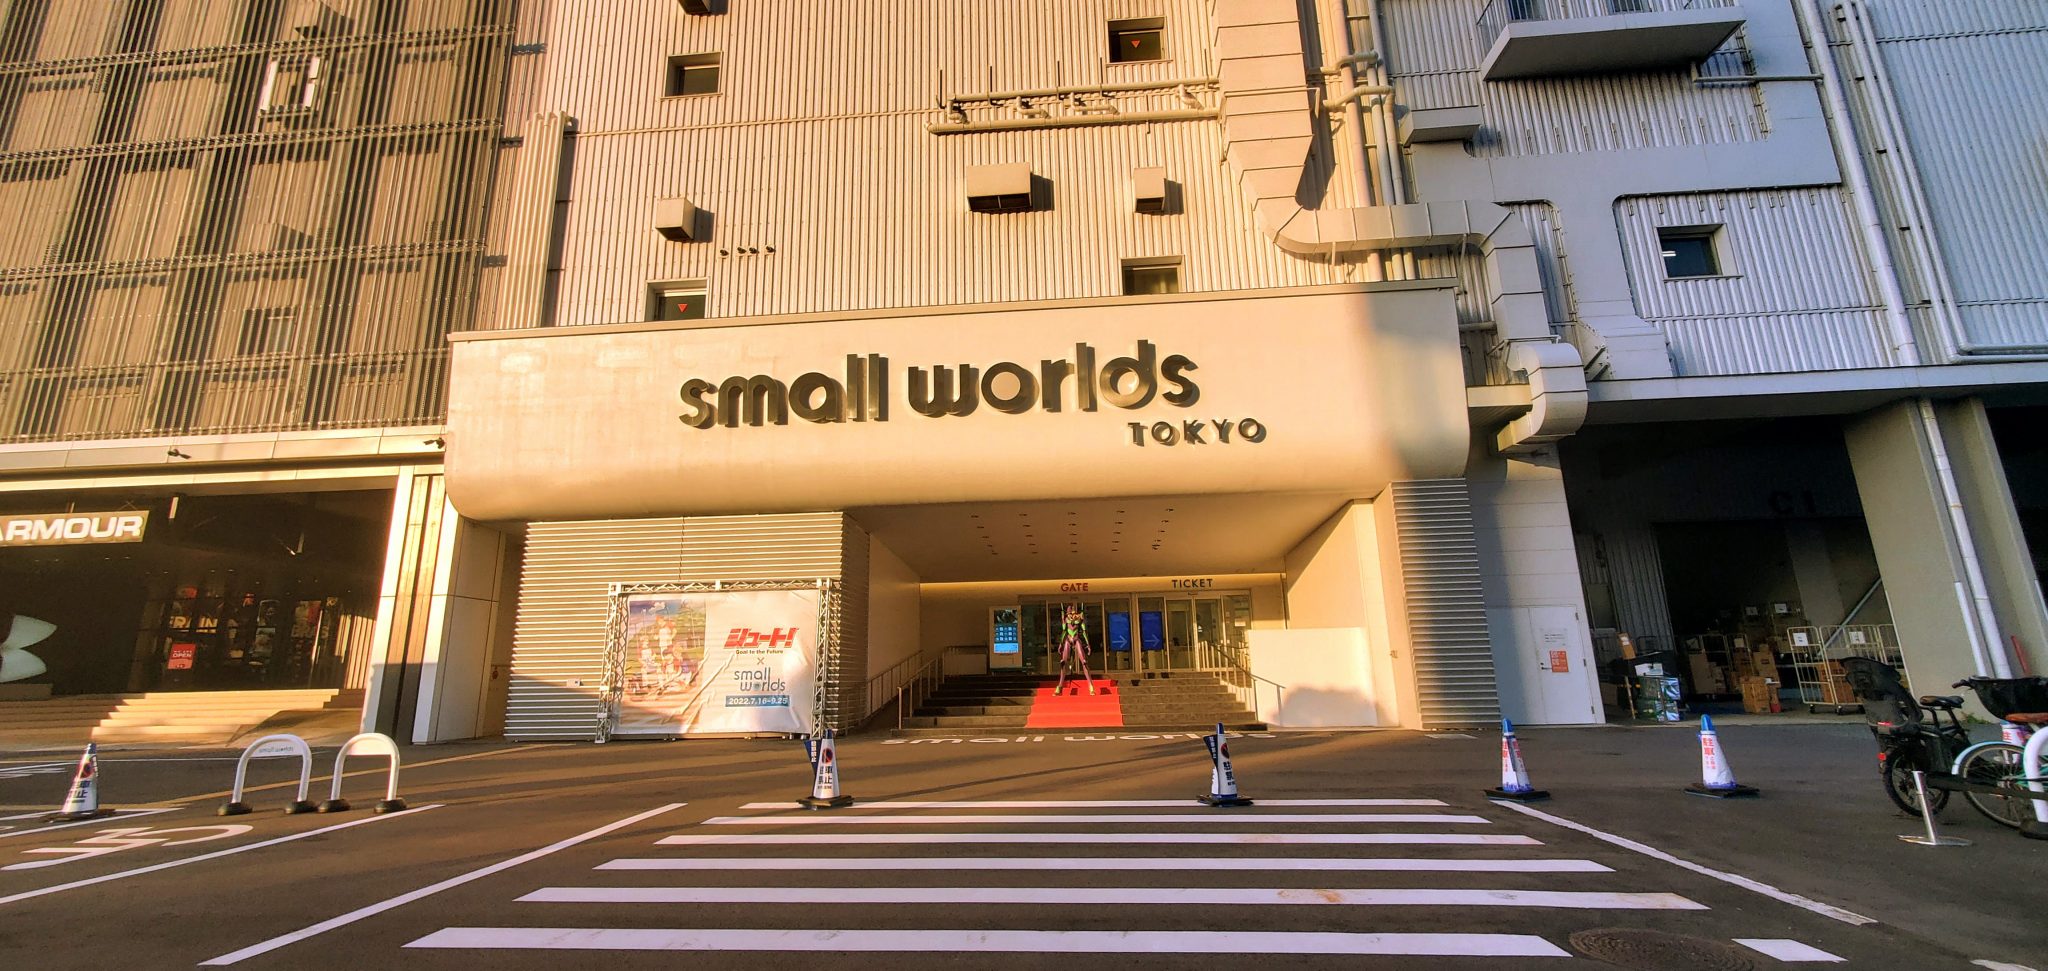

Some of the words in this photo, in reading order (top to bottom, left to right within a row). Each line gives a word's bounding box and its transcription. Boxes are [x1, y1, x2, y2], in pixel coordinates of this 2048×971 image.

[679, 353, 888, 429] small
[907, 339, 1200, 418] worlds
[1127, 417, 1267, 447] TOKYO
[0, 516, 144, 541] RMOUR
[1060, 582, 1089, 592] GATE
[1172, 578, 1214, 589] TICKET
[723, 628, 799, 649] シュート!
[734, 667, 771, 681] small
[740, 678, 786, 691] worlds
[880, 735, 1045, 745] small
